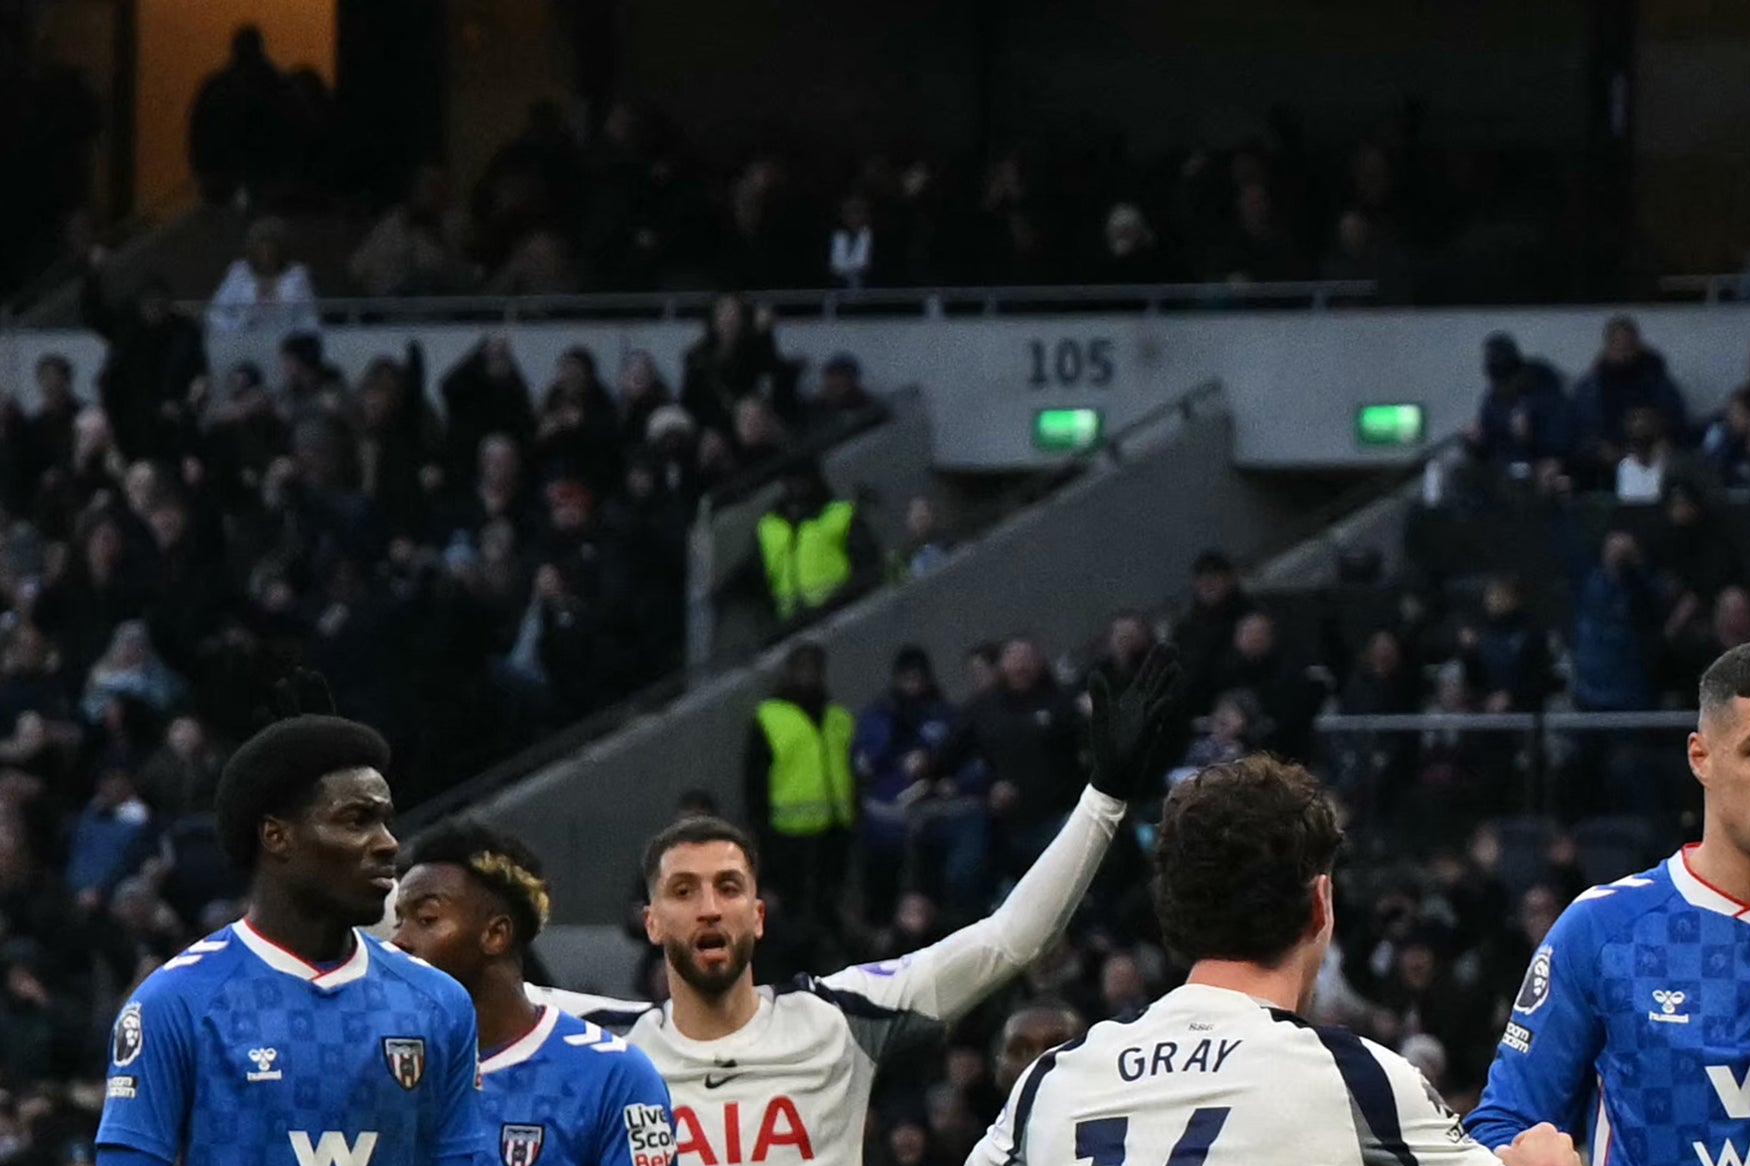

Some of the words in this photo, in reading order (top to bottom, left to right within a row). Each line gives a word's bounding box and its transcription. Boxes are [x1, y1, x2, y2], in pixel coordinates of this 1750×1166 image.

[1029, 338, 1114, 388] 105
[1117, 1039, 1244, 1082] GRAY
[673, 1095, 815, 1166] AIA
